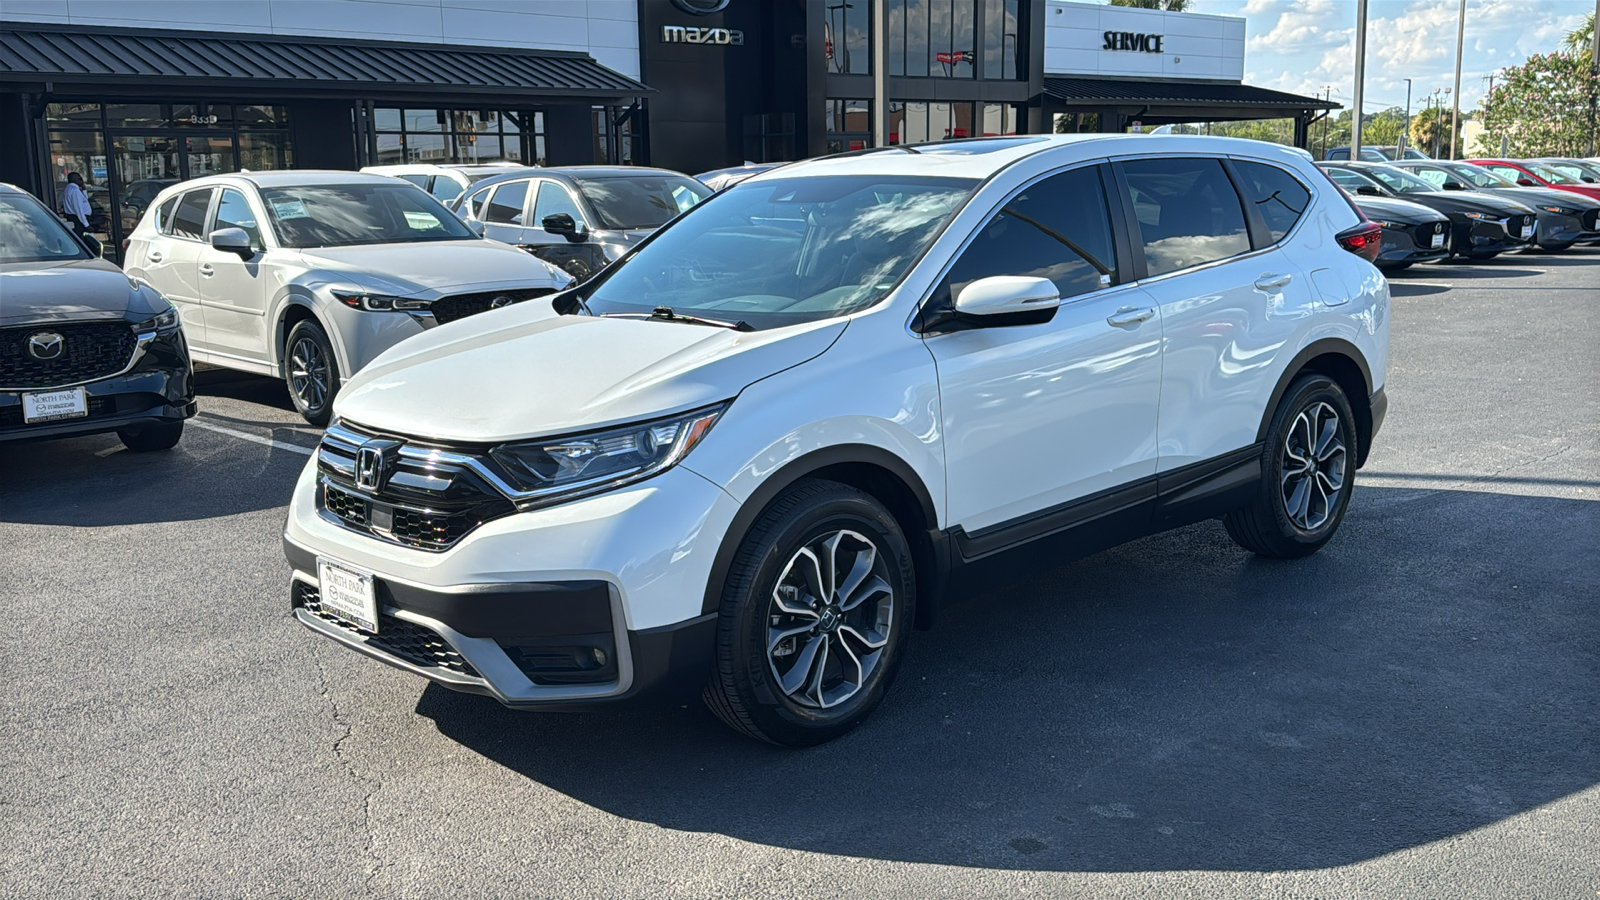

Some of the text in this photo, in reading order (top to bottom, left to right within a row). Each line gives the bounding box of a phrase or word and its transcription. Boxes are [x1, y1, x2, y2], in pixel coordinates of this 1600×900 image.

[1103, 30, 1164, 53] SERVICE
[32, 393, 77, 404] NORTH PARK
[325, 570, 365, 595] NORTH PARK
